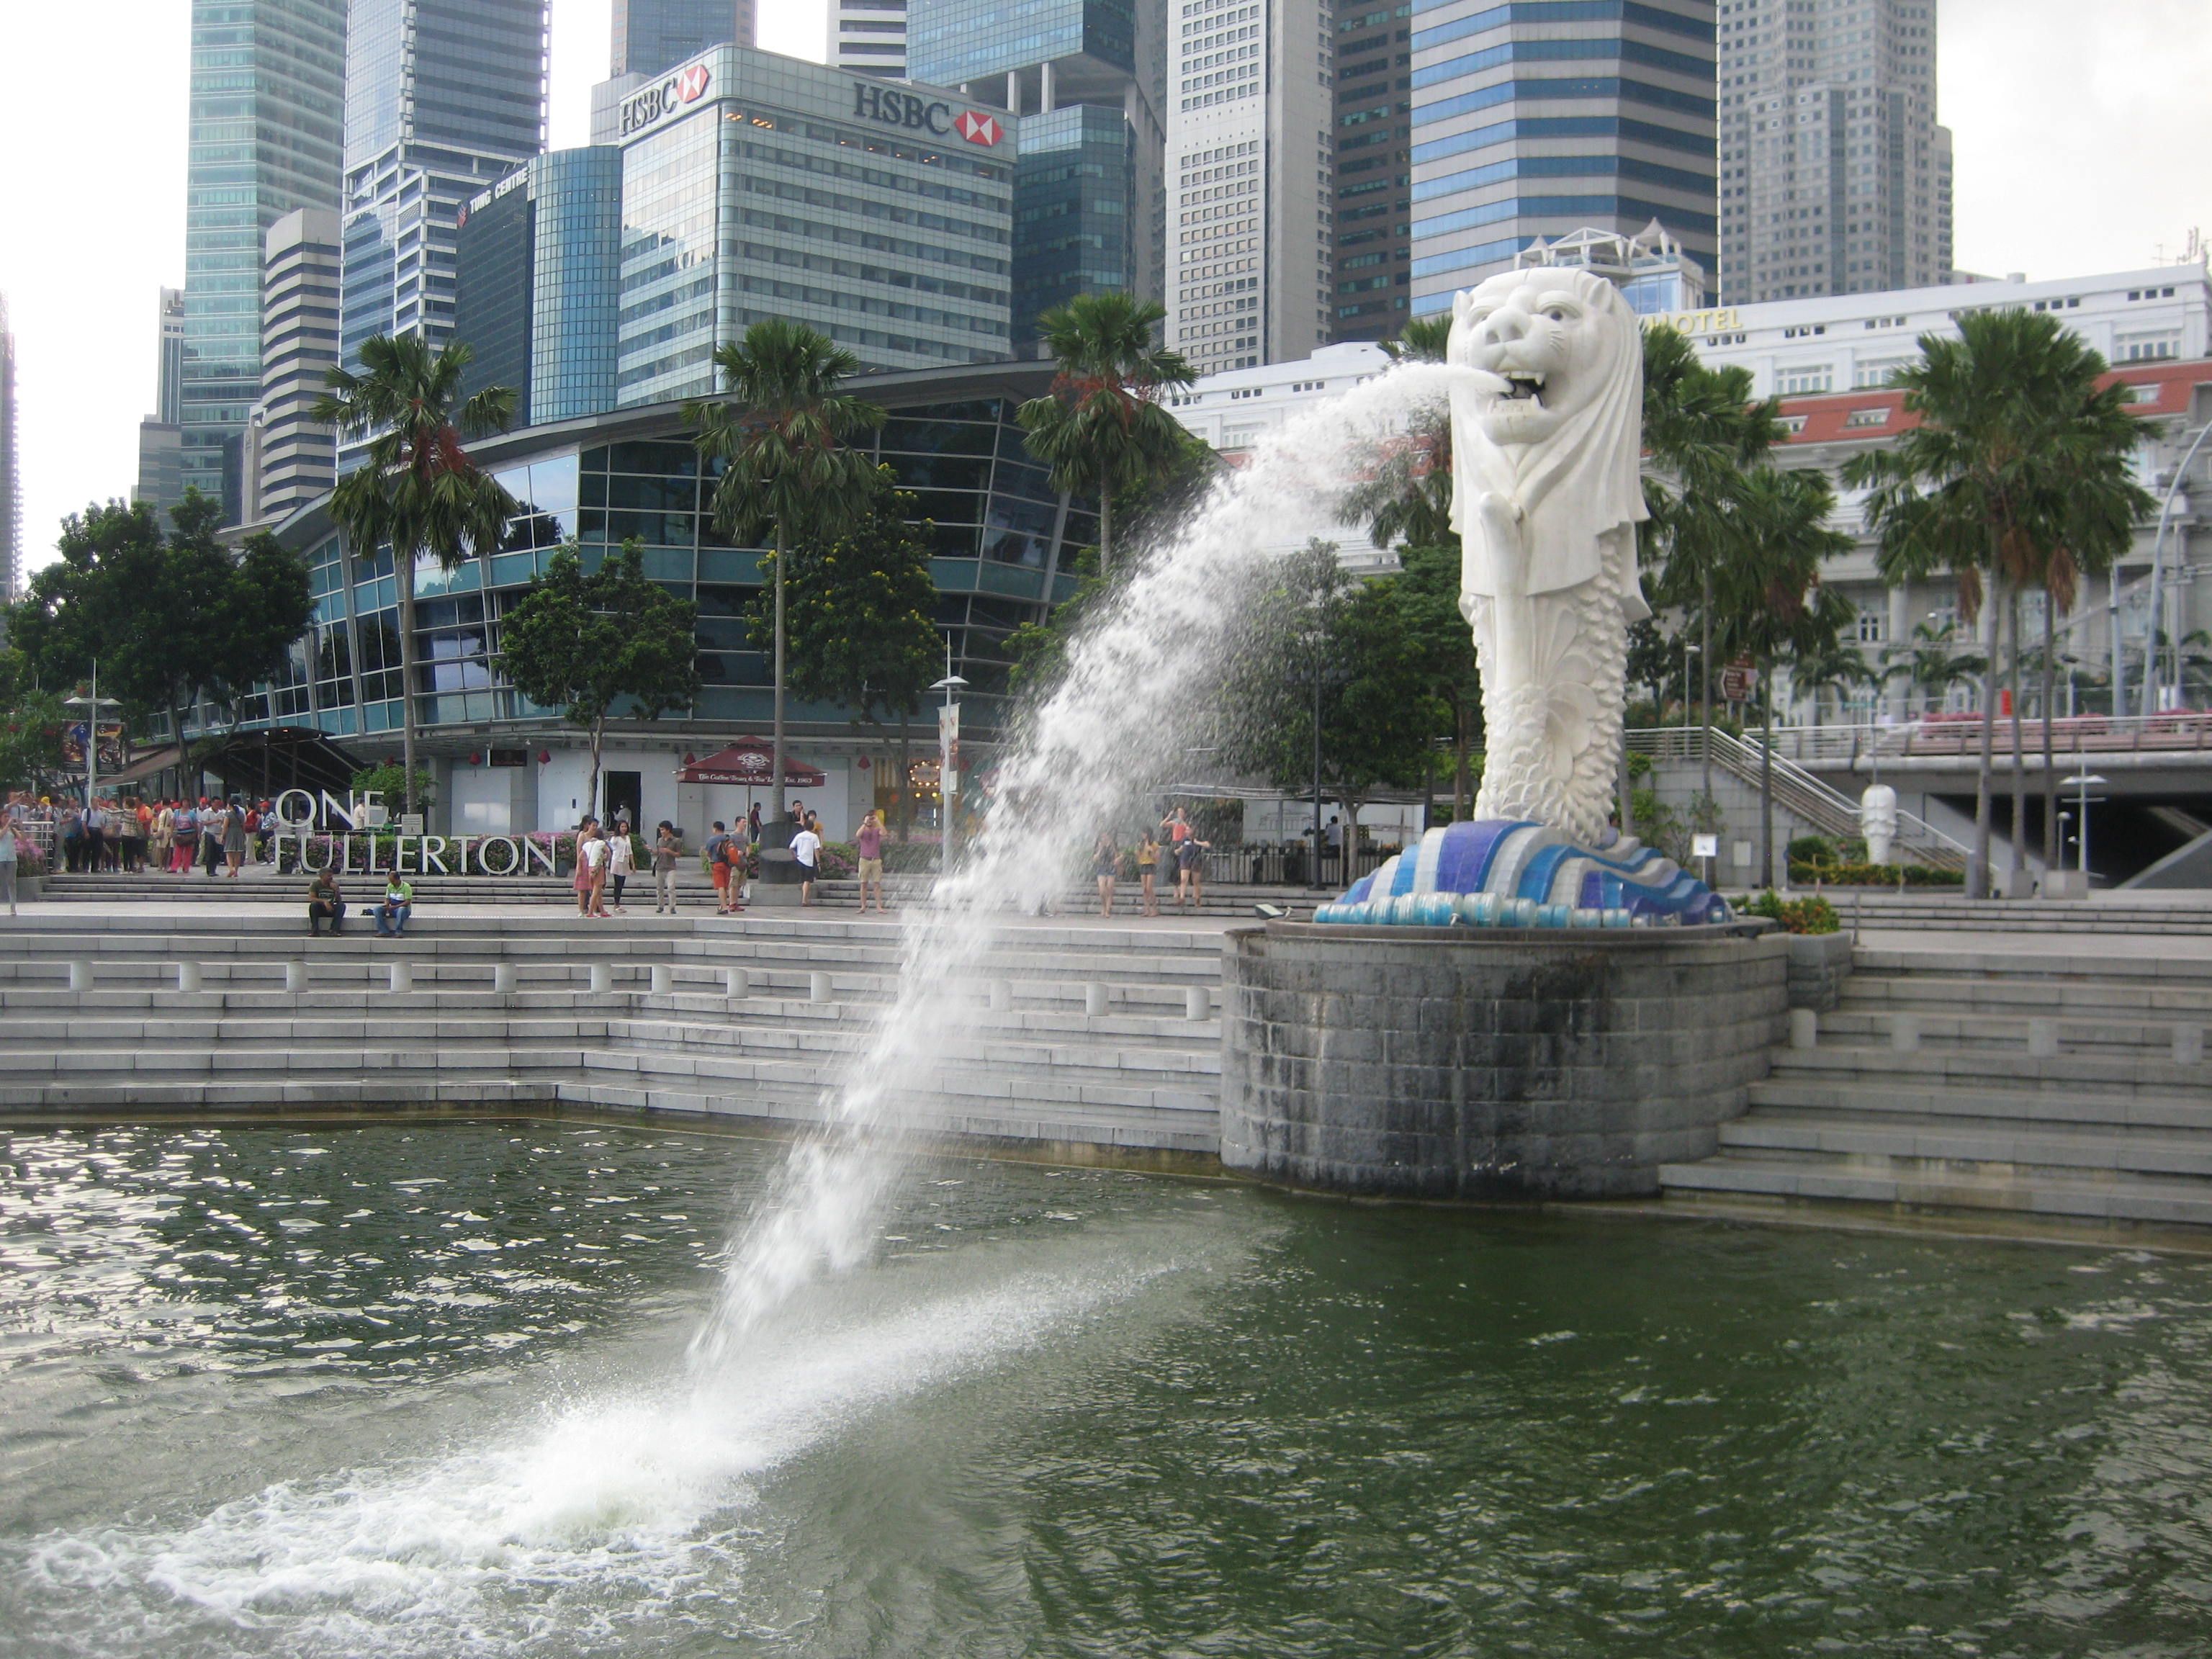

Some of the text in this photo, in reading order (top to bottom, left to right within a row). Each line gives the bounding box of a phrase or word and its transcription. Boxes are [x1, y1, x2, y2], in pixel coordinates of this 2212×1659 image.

[619, 77, 678, 137] HSBC
[854, 82, 950, 135] HSBC
[469, 166, 530, 215] TUNG CENTRE
[275, 788, 385, 830] ONE
[274, 834, 557, 875] FULLERTON
